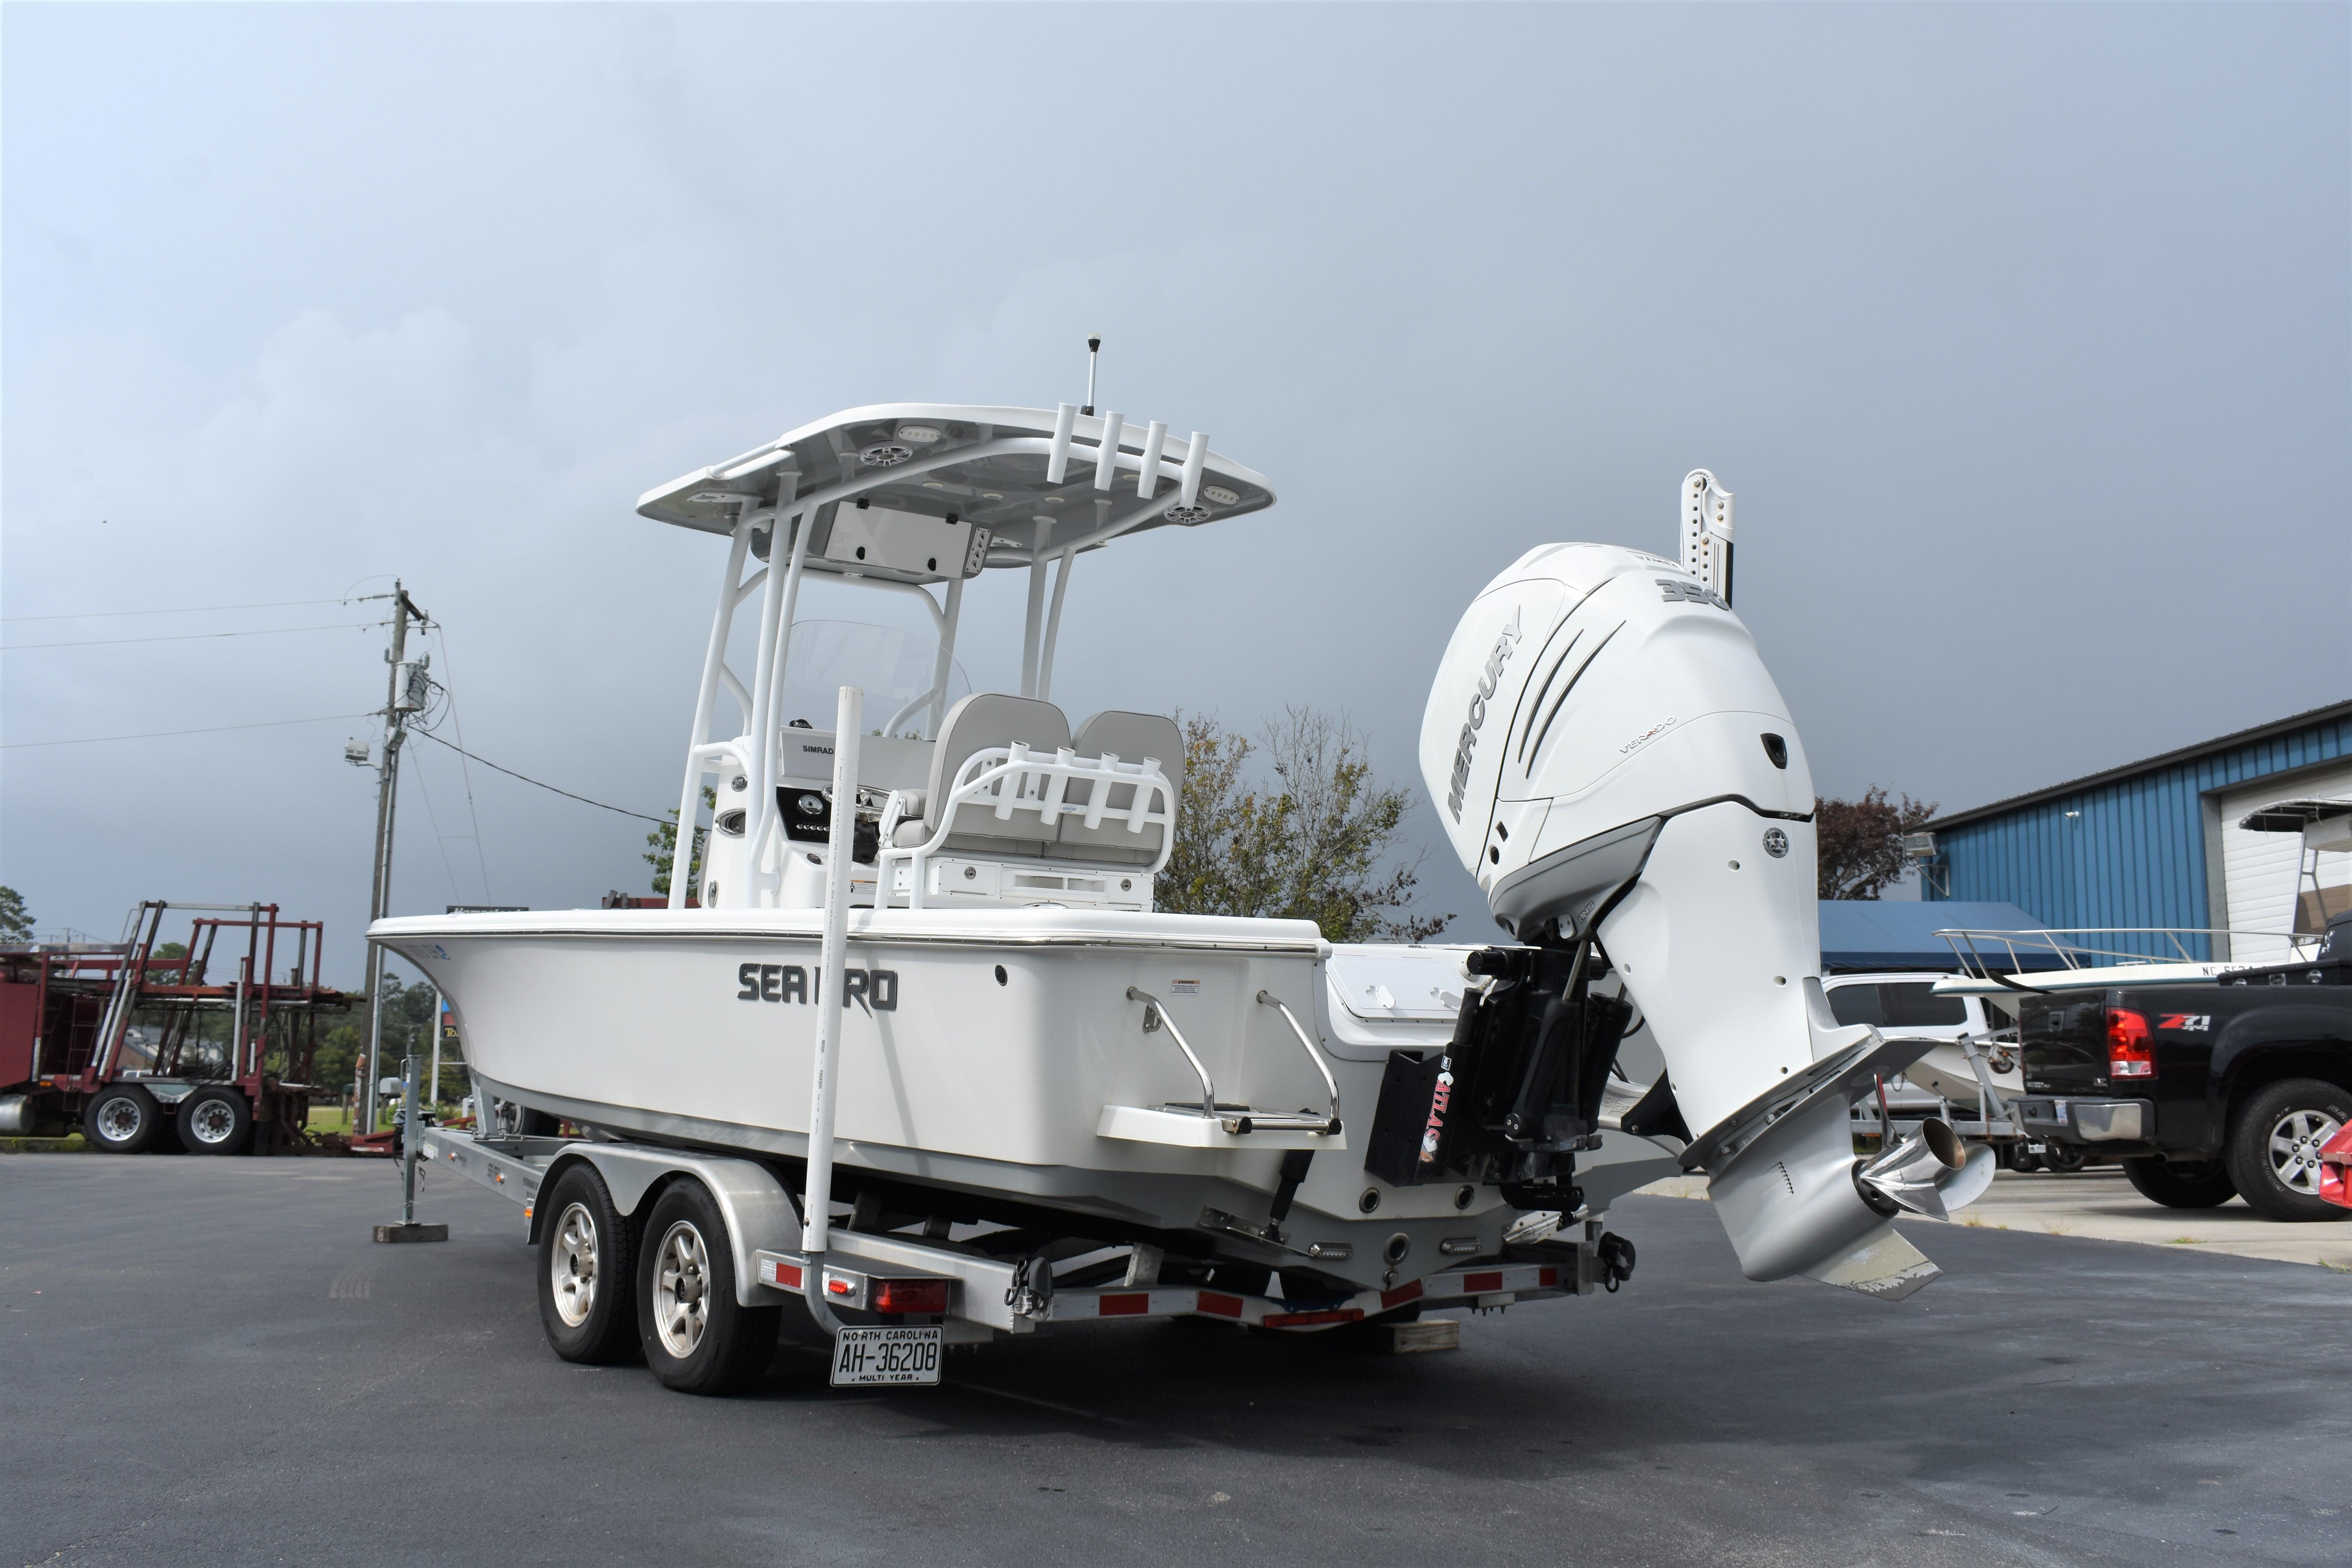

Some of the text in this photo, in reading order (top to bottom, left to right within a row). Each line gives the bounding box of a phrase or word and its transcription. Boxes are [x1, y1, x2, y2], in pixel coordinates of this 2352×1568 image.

[1655, 579, 1730, 611] 350
[1448, 604, 1522, 825] MERCURY
[1619, 715, 1676, 753] VERADO
[802, 745, 834, 755] SIMRAD
[2202, 967, 2216, 976] NC
[737, 963, 807, 1004] SEA
[815, 966, 898, 1018] RO
[445, 1027, 459, 1037] To
[2159, 1013, 2210, 1029] Z71
[1424, 1079, 1451, 1142] ATLAS
[843, 1330, 938, 1341] NORTH CAROLINA
[839, 1342, 937, 1372] AH-36208
